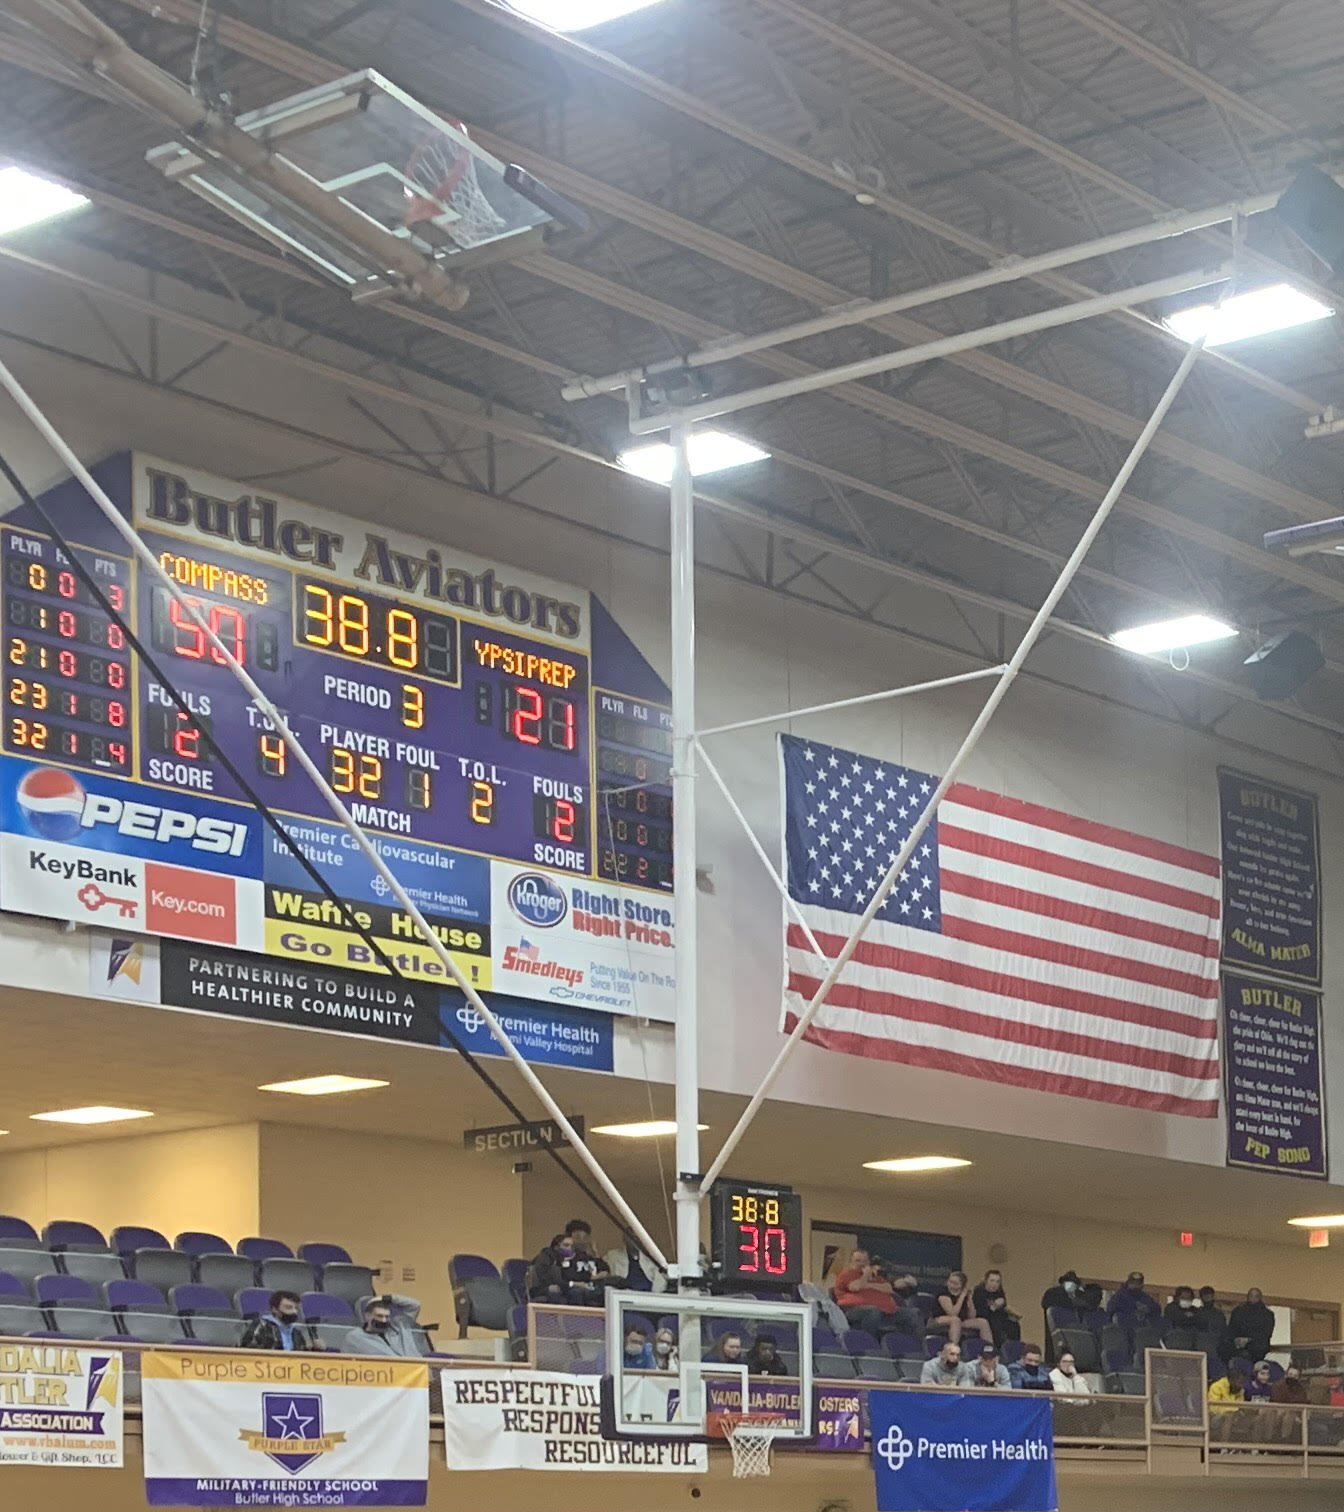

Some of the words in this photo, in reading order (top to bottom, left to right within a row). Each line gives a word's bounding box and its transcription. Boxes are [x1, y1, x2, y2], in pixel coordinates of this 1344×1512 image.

[10, 535, 42, 557] PLYR
[95, 557, 117, 577] PTS
[145, 466, 344, 571] Butler
[353, 533, 581, 639] Aviators
[29, 563, 46, 591] 0
[59, 571, 76, 598] 0
[58, 610, 76, 638] 0
[160, 551, 268, 605] COMPASS
[304, 584, 418, 669] 38.8
[474, 639, 576, 690] YPSIPREP
[10, 638, 46, 669] 21
[59, 650, 76, 677] 0
[108, 662, 124, 689] 0
[10, 678, 47, 710] 23
[324, 674, 391, 710] PERIOD
[402, 683, 424, 729] 3
[601, 696, 625, 714] PLYR
[12, 718, 47, 750] 32
[513, 686, 574, 750] 21
[320, 725, 390, 759] PLAYER
[396, 743, 440, 771] FOUL
[149, 758, 214, 791] SCORE
[261, 734, 285, 775] 4
[332, 749, 382, 800] 32
[458, 757, 507, 787] T.O.L.
[471, 781, 493, 824] 2
[533, 775, 583, 804] FOULS
[80, 792, 248, 857] PEPSI
[351, 803, 411, 833] MATCH
[553, 800, 575, 843] 2
[29, 850, 138, 888] KeyBank
[272, 838, 344, 867] Intitute
[340, 834, 456, 870] Cadiovascular
[533, 843, 585, 871] SCORE
[151, 889, 226, 919] Key.com
[515, 879, 563, 920] Kroger
[572, 887, 621, 918] Right
[623, 898, 675, 928] Store.
[391, 912, 483, 950] House
[572, 909, 622, 938] Right
[624, 921, 676, 949] Price.
[1231, 927, 1265, 957] ALMA
[1270, 943, 1311, 962] MATER
[280, 932, 333, 957] Go
[347, 944, 456, 978] Butle
[502, 945, 585, 988] Smedleys
[189, 957, 308, 990] PARTNERING
[314, 978, 337, 995] TO
[345, 984, 397, 1005] BUILD
[403, 993, 415, 1008] A
[191, 980, 294, 1010] HEALTHIER
[301, 998, 413, 1028] COMMUNITY
[1240, 988, 1302, 1017] BUTLER
[523, 1035, 553, 1053] Valley
[553, 1040, 594, 1056] Hospital
[551, 1022, 600, 1045] Health
[1245, 1136, 1271, 1160] PEP
[1277, 1146, 1312, 1163] SONG
[738, 1225, 787, 1275] 30
[181, 1359, 249, 1381] Purple
[254, 1361, 292, 1381] Star
[300, 1362, 395, 1385] Recipient
[453, 1380, 600, 1408] RESPECTFUL
[0, 1411, 94, 1431] ASSOCIATION
[502, 1408, 600, 1435] RESPONS
[253, 1439, 298, 1451] PURPLE
[303, 1439, 332, 1450] STAR
[544, 1439, 697, 1466] RESOURCEFUL
[917, 1437, 988, 1460] Premier
[992, 1439, 1049, 1461] Health
[196, 1478, 320, 1492] MILITARY-FRIENDLY
[324, 1479, 379, 1492] SCHOOL
[234, 1493, 271, 1505] Butler
[273, 1493, 300, 1507] High
[302, 1493, 345, 1505] School
